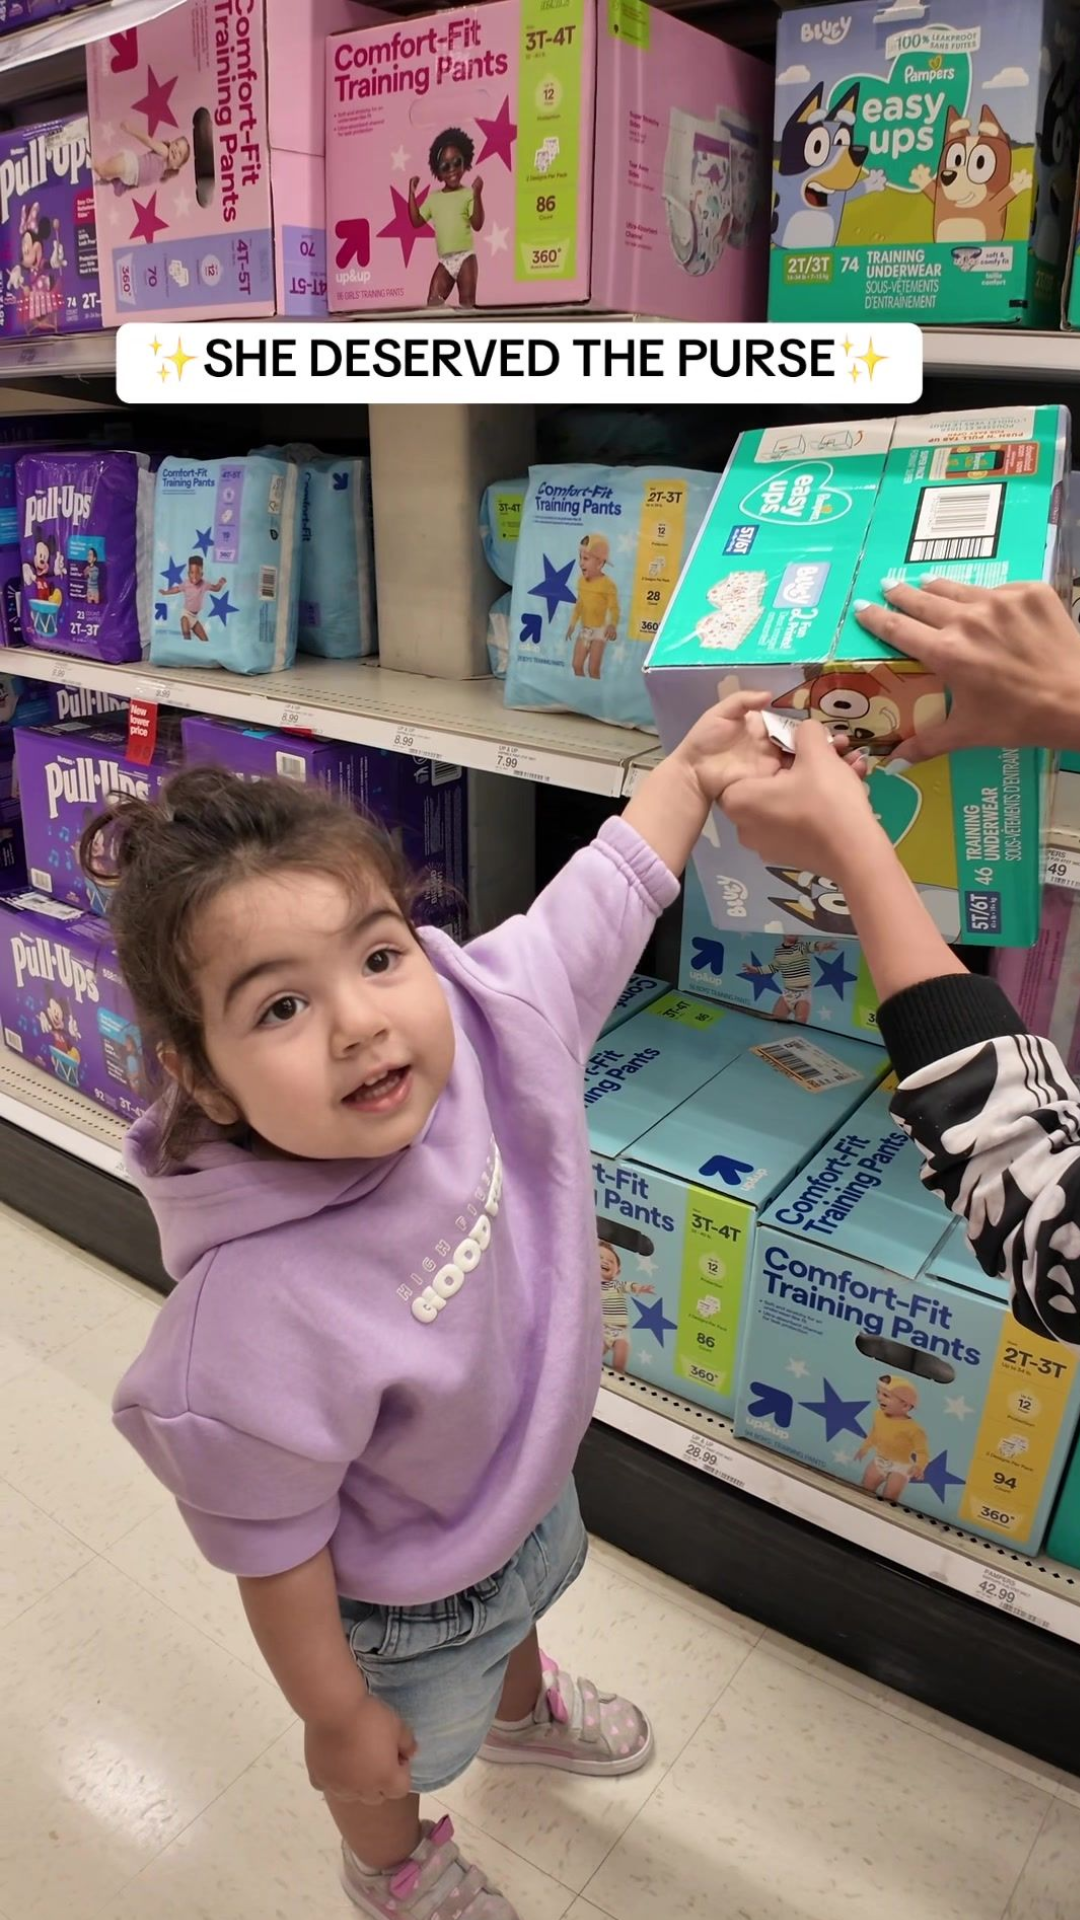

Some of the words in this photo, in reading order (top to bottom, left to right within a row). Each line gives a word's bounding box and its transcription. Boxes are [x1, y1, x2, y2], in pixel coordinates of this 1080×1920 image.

[335, 18, 481, 72] Comfort-Fit
[525, 25, 576, 51] 3T-4T
[896, 34, 930, 50] 100%
[930, 41, 950, 50] SANS
[951, 39, 977, 50] FUITES
[932, 32, 977, 42] LEAKPROOF
[334, 65, 430, 102] Training
[437, 53, 508, 85] Pants
[904, 65, 955, 84] Pampers
[543, 89, 555, 100] 12
[862, 92, 945, 124] easy
[869, 126, 934, 159] ups
[219, 133, 239, 223] Pants
[535, 195, 556, 213] 86
[300, 241, 315, 257] 70
[866, 249, 925, 264] TRAINING
[208, 264, 216, 276] 12
[236, 239, 251, 295] 4T-5T
[788, 255, 830, 274] 2T/3T
[840, 257, 860, 273] 74
[866, 263, 942, 278] UNDERWEAR
[147, 266, 158, 287] 70
[865, 278, 940, 294] SOUS-VÊTEMENTS
[67, 297, 77, 307] 74
[162, 468, 208, 478] Comfort-Fit
[162, 478, 192, 489] Training
[192, 478, 216, 488] Pants
[537, 481, 614, 500] Comfort-Fit
[647, 491, 683, 504] 2T-3T
[759, 480, 789, 517] ups
[780, 474, 815, 517] easy
[535, 496, 580, 517] Training
[582, 498, 622, 516] Pants
[657, 527, 666, 535] 12
[733, 526, 756, 554] 5T/6T
[647, 590, 661, 601] 28
[76, 610, 85, 620] 23
[131, 704, 147, 716] New
[281, 713, 299, 724] 8.99
[130, 716, 150, 727] lower
[130, 725, 148, 737] price
[394, 735, 414, 747] 8.99
[497, 755, 518, 769] 7.99
[963, 804, 983, 861] TRAINING
[981, 786, 1001, 861] UNDERWEAR
[1001, 793, 1022, 861] SOUS-VÊTEMENTS
[974, 866, 994, 885] 46
[969, 893, 989, 930] 5T/6T
[662, 1001, 691, 1020] 3T-4T
[605, 1048, 661, 1081] Pants
[775, 1134, 871, 1225] Comfort-Fit
[802, 1171, 882, 1235] Training
[857, 1131, 910, 1174] Pants
[604, 1188, 675, 1232] Pants
[692, 1213, 741, 1242] 3T-4T
[396, 1239, 451, 1302] HIGH
[412, 1214, 491, 1324] GOOD
[707, 1261, 719, 1273] 12
[765, 1246, 952, 1330] Comfort-Fit
[762, 1269, 883, 1336] Training
[891, 1317, 980, 1366] Pants
[696, 1332, 716, 1348] 86
[1003, 1347, 1067, 1378] 2T-3T
[1018, 1399, 1031, 1411] 12
[685, 1444, 718, 1465] 28.99
[993, 1471, 1017, 1489] 94
[980, 1505, 1015, 1525] 360°
[984, 1569, 1016, 1587] PAMPERS
[979, 1581, 1015, 1603] 42.99
